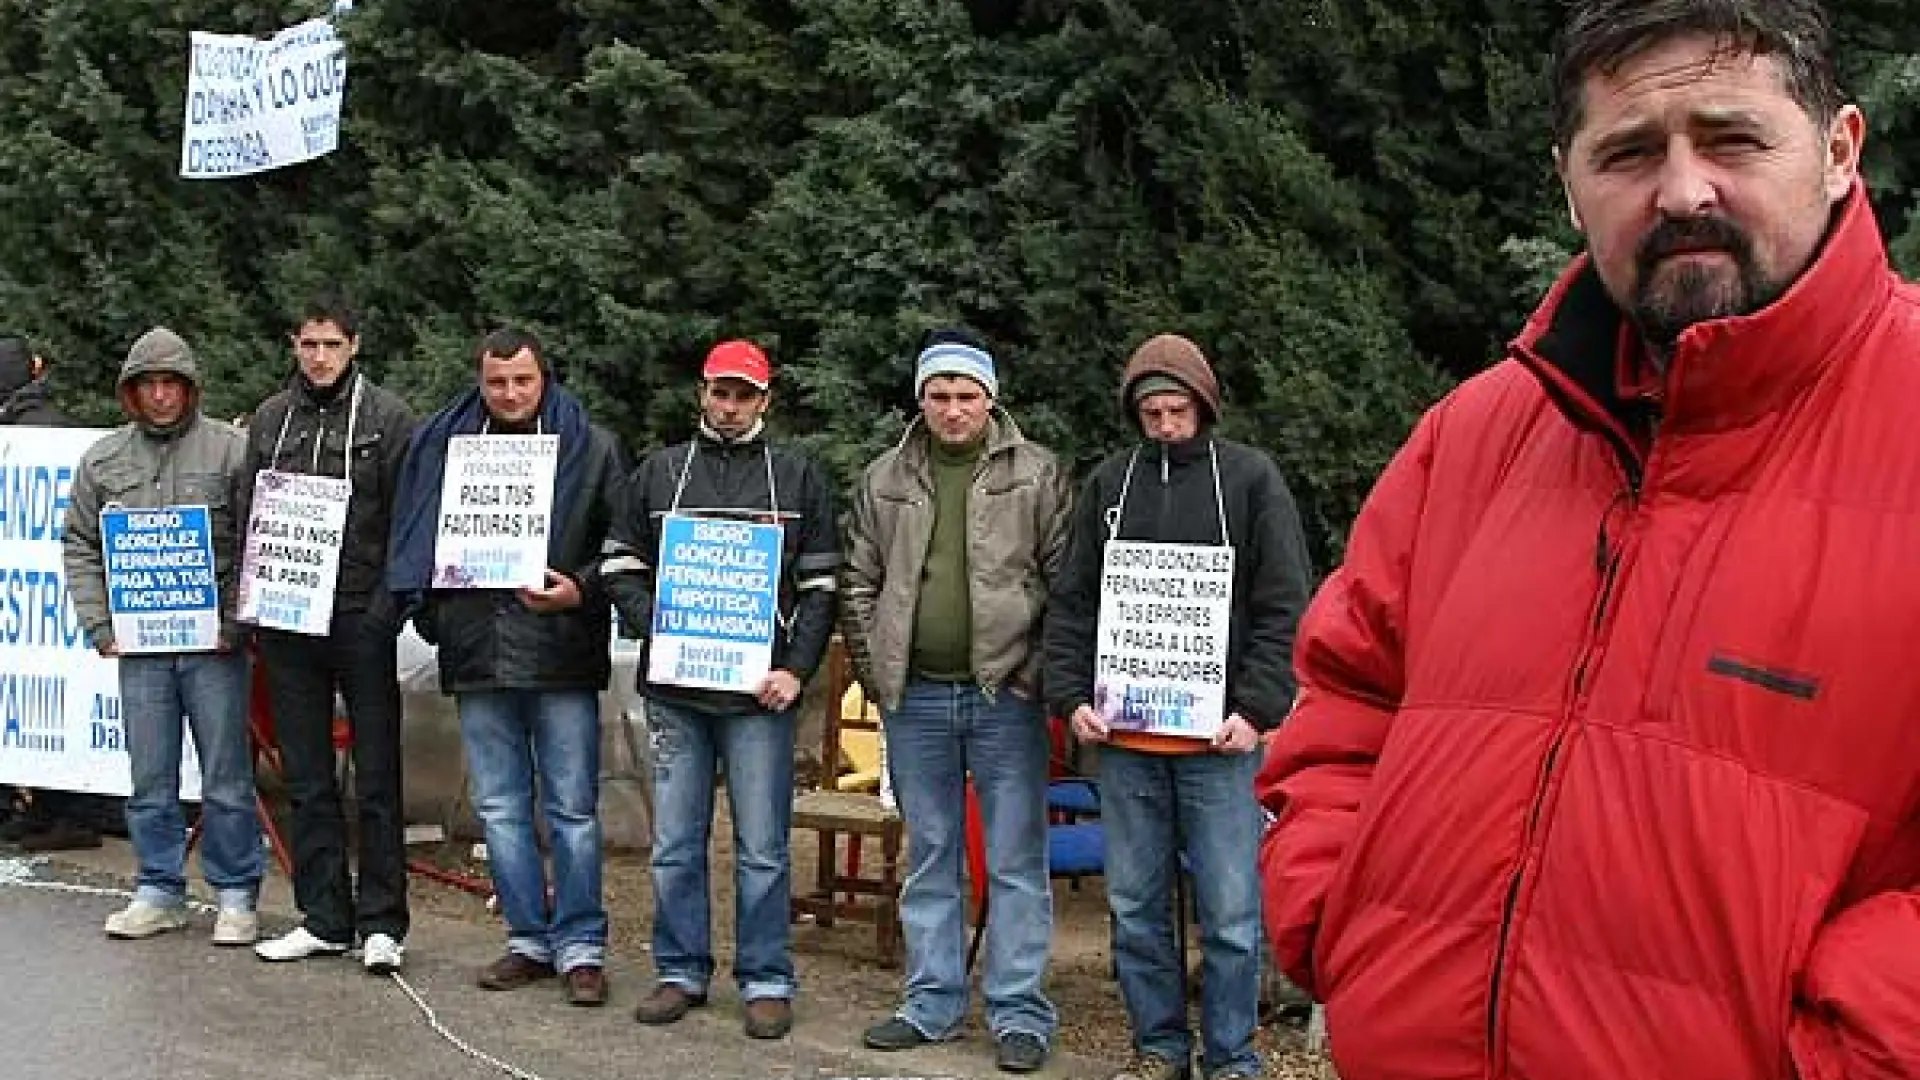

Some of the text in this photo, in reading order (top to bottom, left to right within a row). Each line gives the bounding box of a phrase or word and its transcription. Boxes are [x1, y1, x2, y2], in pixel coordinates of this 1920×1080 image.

[269, 68, 298, 109] LO
[461, 485, 535, 508] PAGA TUS
[252, 517, 289, 538] PAGA
[307, 527, 339, 547] NOS
[442, 514, 545, 537] FACTURAS YA
[258, 543, 324, 566] MANDAS
[1107, 549, 1230, 573] ISIDRO GONZALEZ
[111, 569, 210, 589] PAGA YA TUS
[256, 566, 321, 588] AL PARO
[122, 588, 206, 607] FACTURAS
[672, 588, 760, 614] HIPOTECA
[1193, 580, 1228, 600] MIRA
[661, 609, 768, 637] TU MANSIÓN
[1117, 601, 1211, 627] TUS ERRORES
[1110, 628, 1215, 655] Y PAGA A LOS
[1100, 655, 1223, 684] TRABAJADORES
